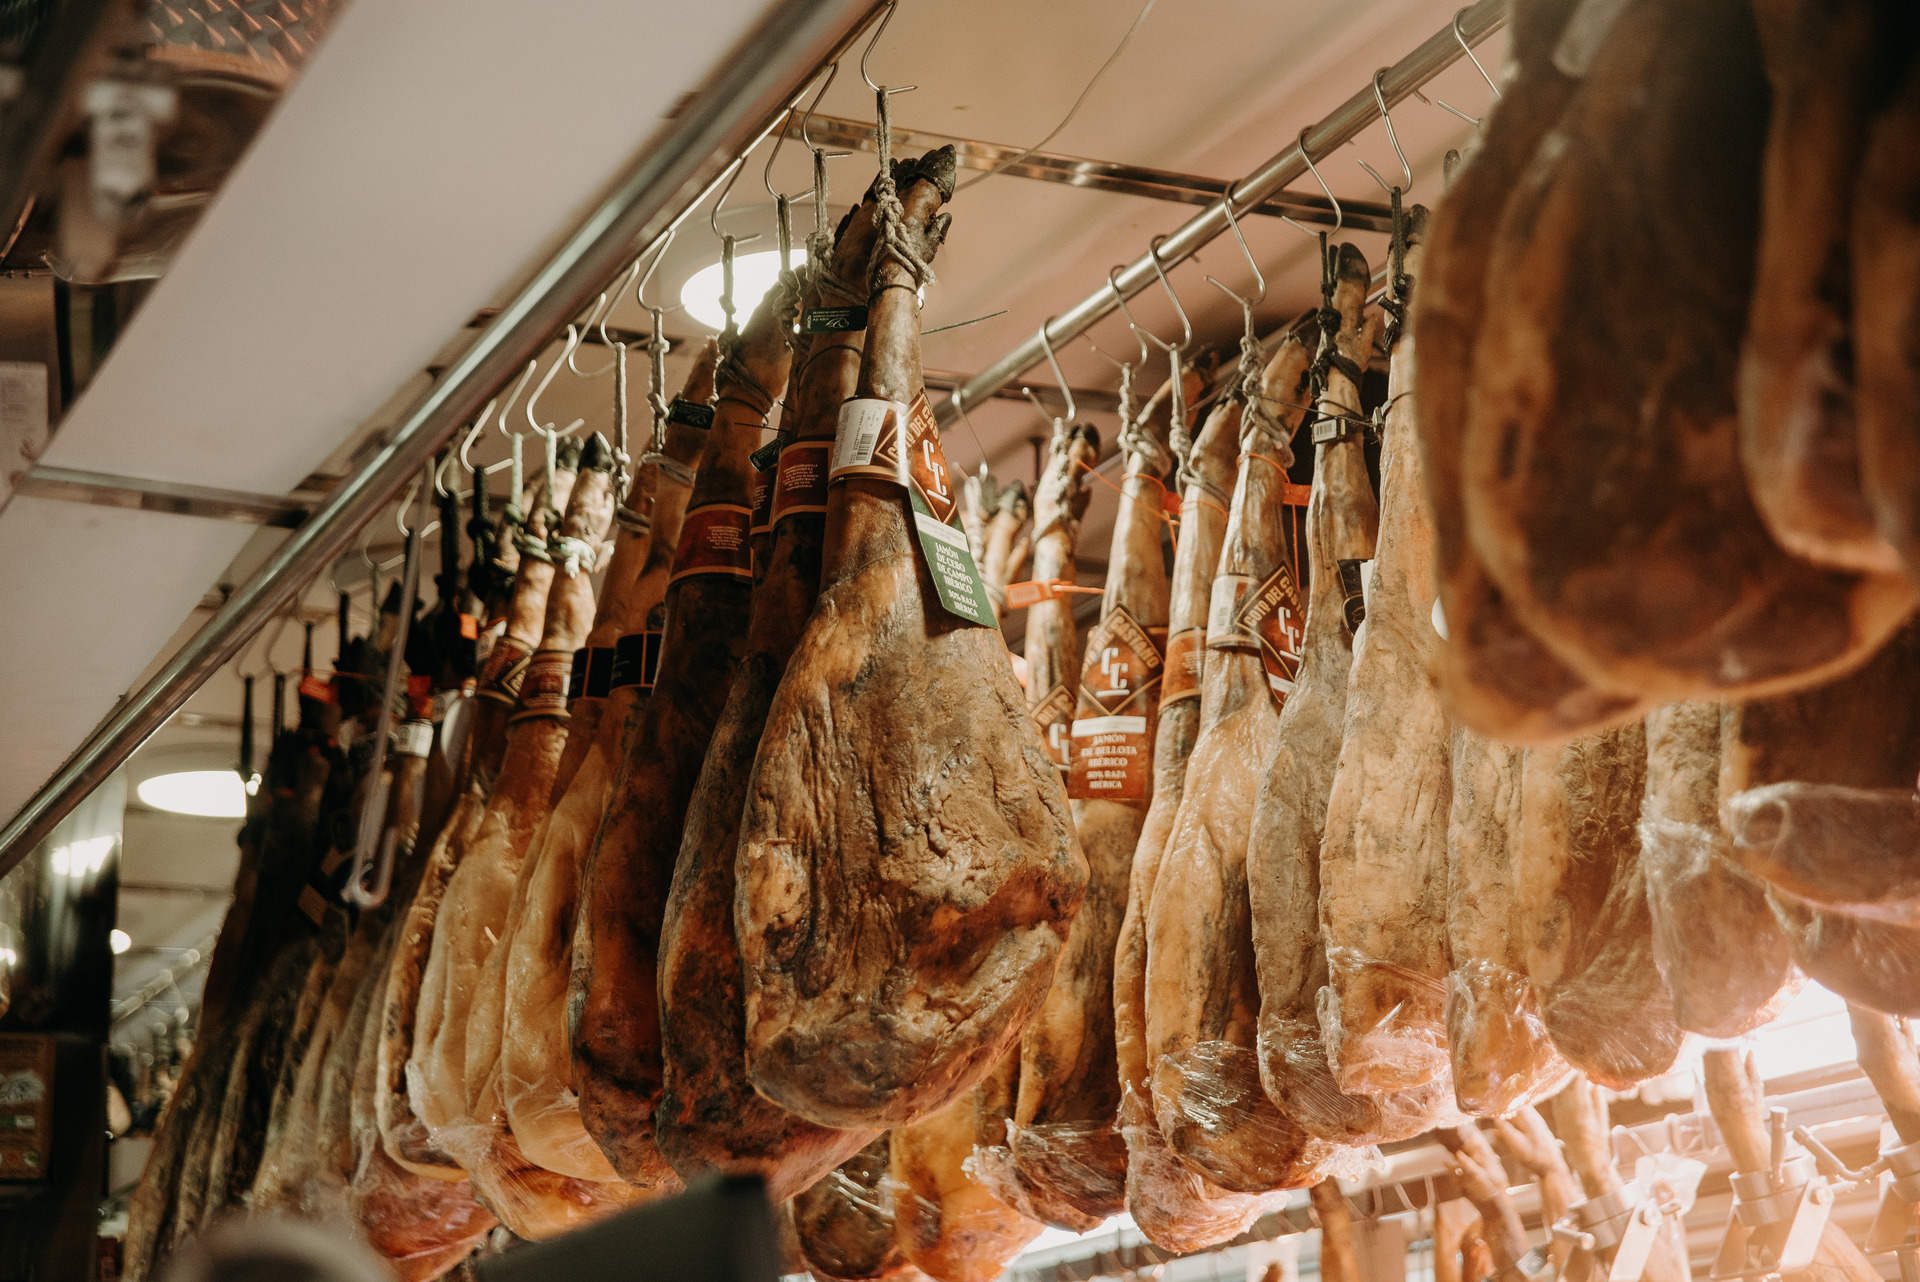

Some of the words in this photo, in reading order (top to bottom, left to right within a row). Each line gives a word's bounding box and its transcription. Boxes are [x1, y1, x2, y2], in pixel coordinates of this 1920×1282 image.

[909, 414, 928, 438] DEL
[934, 542, 960, 561] JAMÓN
[946, 557, 966, 572] CEBO
[947, 566, 973, 585] CAMPO
[1243, 599, 1272, 627] COTO
[1263, 585, 1285, 606] DEL
[1092, 733, 1127, 746] JAMÓN
[1094, 745, 1138, 757] BELLOTA
[1087, 756, 1128, 768] IBÉRICO
